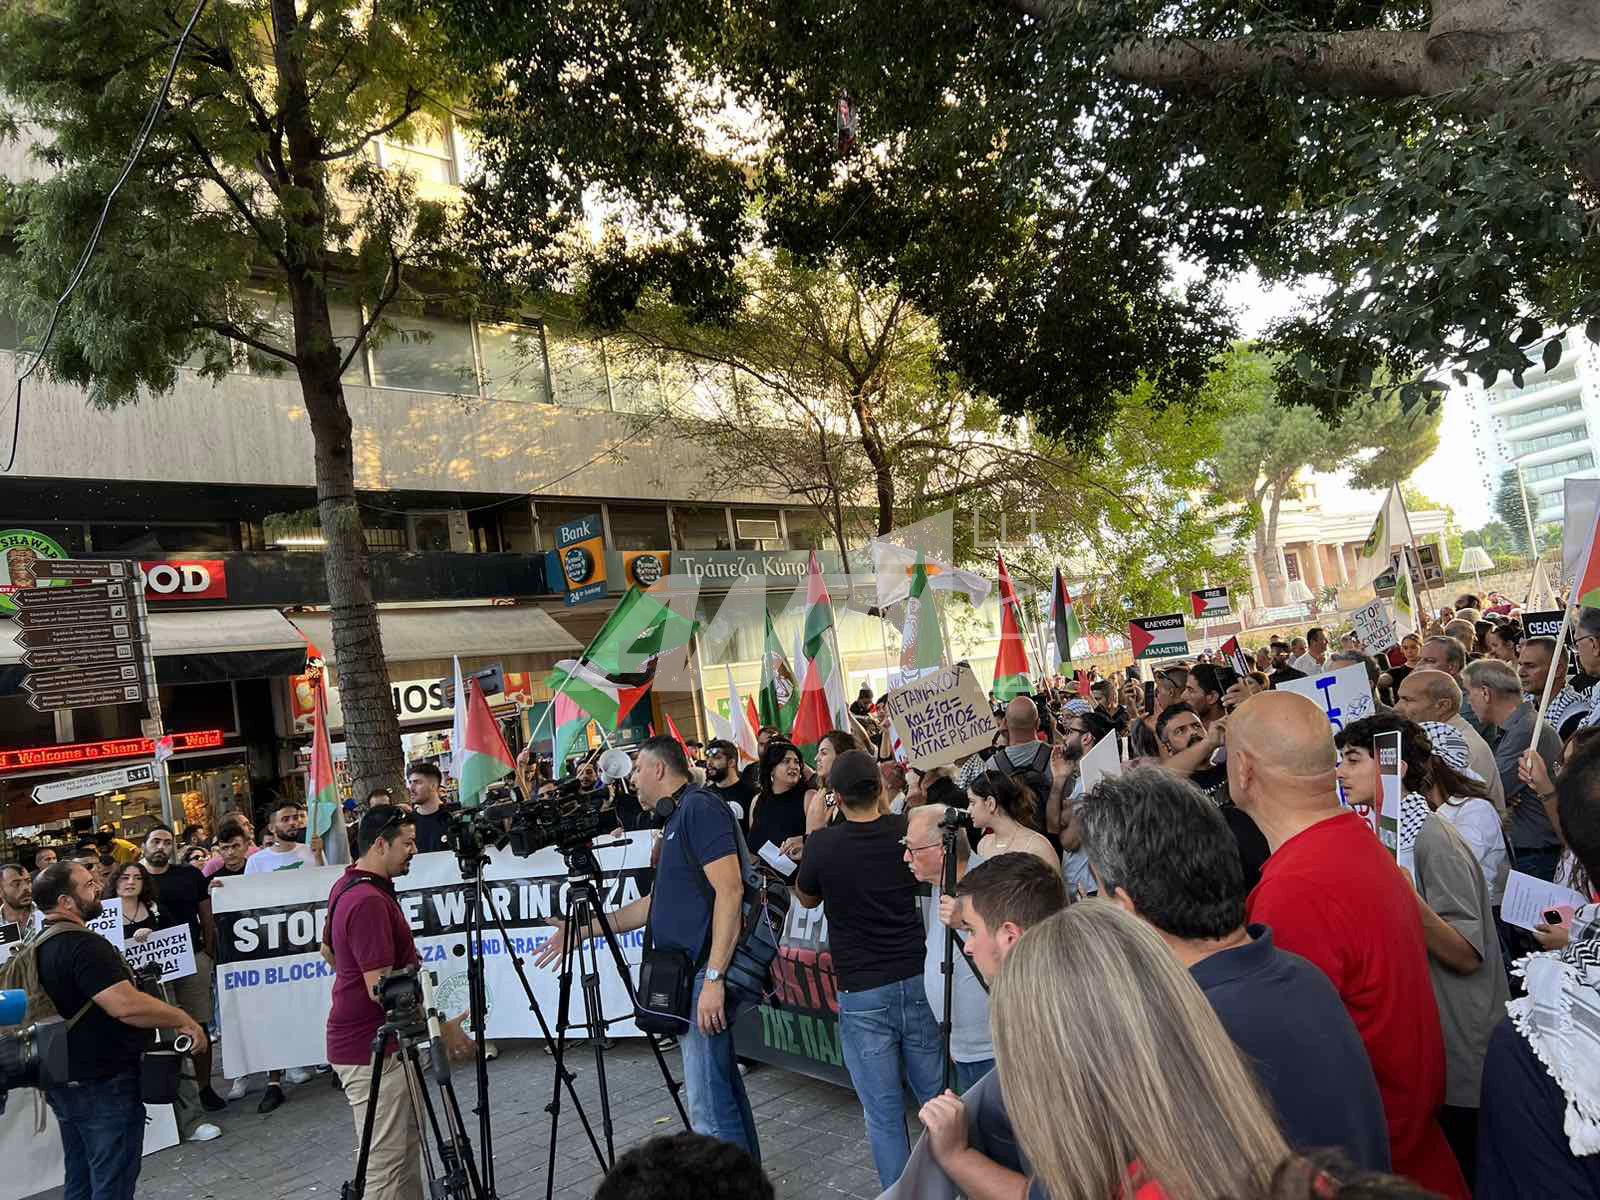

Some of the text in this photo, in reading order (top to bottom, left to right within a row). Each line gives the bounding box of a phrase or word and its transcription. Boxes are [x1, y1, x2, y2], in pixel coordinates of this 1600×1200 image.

[561, 521, 591, 543] Bank
[143, 564, 210, 593] OD
[680, 556, 758, 585] Τράπεζα
[1355, 603, 1380, 626] STOP
[85, 747, 98, 757] to
[102, 743, 138, 755] Sham
[519, 883, 552, 920] IN
[124, 933, 188, 957] ΑΤΑΠΑΥΣΗ
[128, 944, 187, 967] ΟΥ ΠΥΡΟΣ
[224, 970, 260, 990] END
[422, 944, 448, 962] ZA
